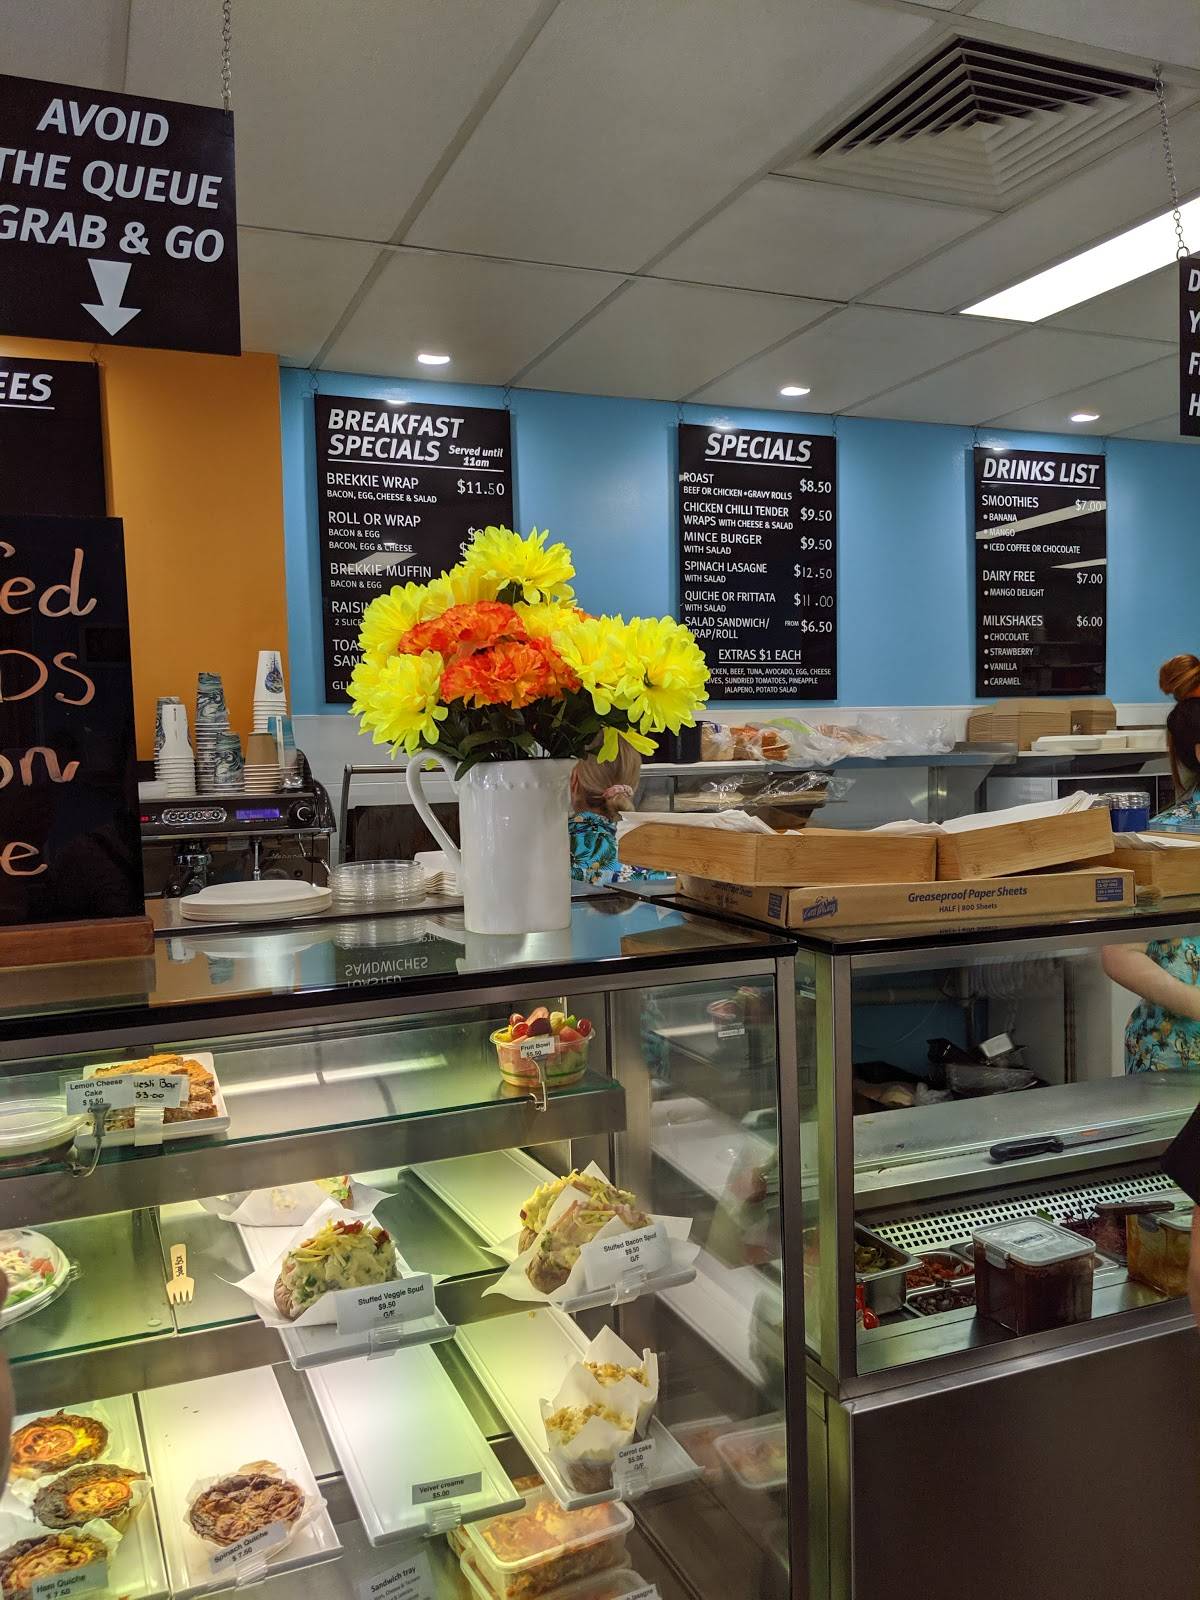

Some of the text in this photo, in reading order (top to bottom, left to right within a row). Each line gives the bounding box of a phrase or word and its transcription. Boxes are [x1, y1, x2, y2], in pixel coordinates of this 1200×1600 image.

[36, 98, 169, 147] AVOID
[0, 147, 223, 209] THE QUEUE
[0, 204, 225, 263] GRAB & GO
[328, 408, 464, 438] BREAKFAST
[327, 434, 503, 462] SPECIALS Served until
[705, 432, 812, 463] SPECIALS
[463, 458, 489, 468] 11am
[983, 458, 1100, 484] DRINKS LIST
[326, 472, 505, 496] BREKKIE WRAP $11.50
[683, 472, 832, 494] ROAST $8.50
[326, 489, 357, 500] BACON,
[376, 493, 405, 502] CHEESE
[406, 494, 412, 502] &
[413, 495, 437, 503] SALAD
[683, 486, 700, 495] BEEF
[701, 487, 712, 495] OR
[713, 488, 742, 497] CHICKEN
[771, 492, 792, 500] ROLLS
[981, 494, 1101, 512] SMOOTHIES $7.00
[328, 511, 421, 527] ROLL OR WRAP
[683, 502, 833, 522] CHICKEN CHILLI TENDER $9.50
[989, 513, 1017, 522] BANANA
[683, 515, 793, 530] WRAPS WITH CHEESE & SALAD
[328, 529, 355, 537] BACON
[364, 530, 380, 538] EGG
[989, 528, 1015, 537] MANGO
[329, 541, 413, 553] BACON, EGG & CHEESE
[684, 531, 833, 551] MINCE BURGER $9.50
[989, 543, 1081, 553] ICED COFFEE OR CHOCOLATE
[684, 545, 731, 555] WITH SALAD
[330, 563, 432, 578] BREKKIE MUFFIN
[684, 561, 833, 579] SPINACH LASAGNE $12.50
[982, 570, 1103, 584] DAIRY FREE $7.00
[330, 580, 382, 589] BACON & EGG
[684, 574, 726, 583] WITH SALAD
[684, 590, 720, 602] QUICHE
[722, 591, 735, 602] OR
[736, 591, 776, 603] FRITTATA
[989, 588, 1044, 597] MANGO DELIGHT
[684, 604, 726, 613] WITH SALAD
[335, 618, 340, 626] 2
[684, 616, 715, 627] SALAD
[717, 618, 770, 629] SANDWICH/
[801, 619, 833, 634] $6.50
[982, 615, 1103, 628] MILKSHAKES $6.00
[989, 633, 1029, 641] CHOCOLATE
[718, 648, 802, 662] EXTRAS $1 EACH
[989, 648, 1034, 656] STRAWBERRY
[989, 663, 1017, 671] VANILLA
[789, 677, 818, 685] PINEAPPLE
[989, 677, 1021, 686] CARAMEL
[908, 885, 1028, 903] Greaseproof Paper Sheets
[939, 905, 956, 913] HALF
[69, 1079, 123, 1090] Lemon Cheese
[160, 1079, 179, 1089] Bar
[85, 1090, 103, 1098] Cake
[603, 1232, 657, 1252] Stuffed Bacon Spud
[358, 1284, 424, 1306] Stuffed Veggie Spud
[378, 1301, 396, 1311] $9.50
[618, 1444, 652, 1458] Carrot cake
[419, 1479, 465, 1494] Velvet creams
[214, 1531, 268, 1563] Spinach Quiche
[36, 1574, 86, 1593] Ham Quiche
[370, 1573, 402, 1593] Sandwich
[402, 1566, 416, 1578] tray
